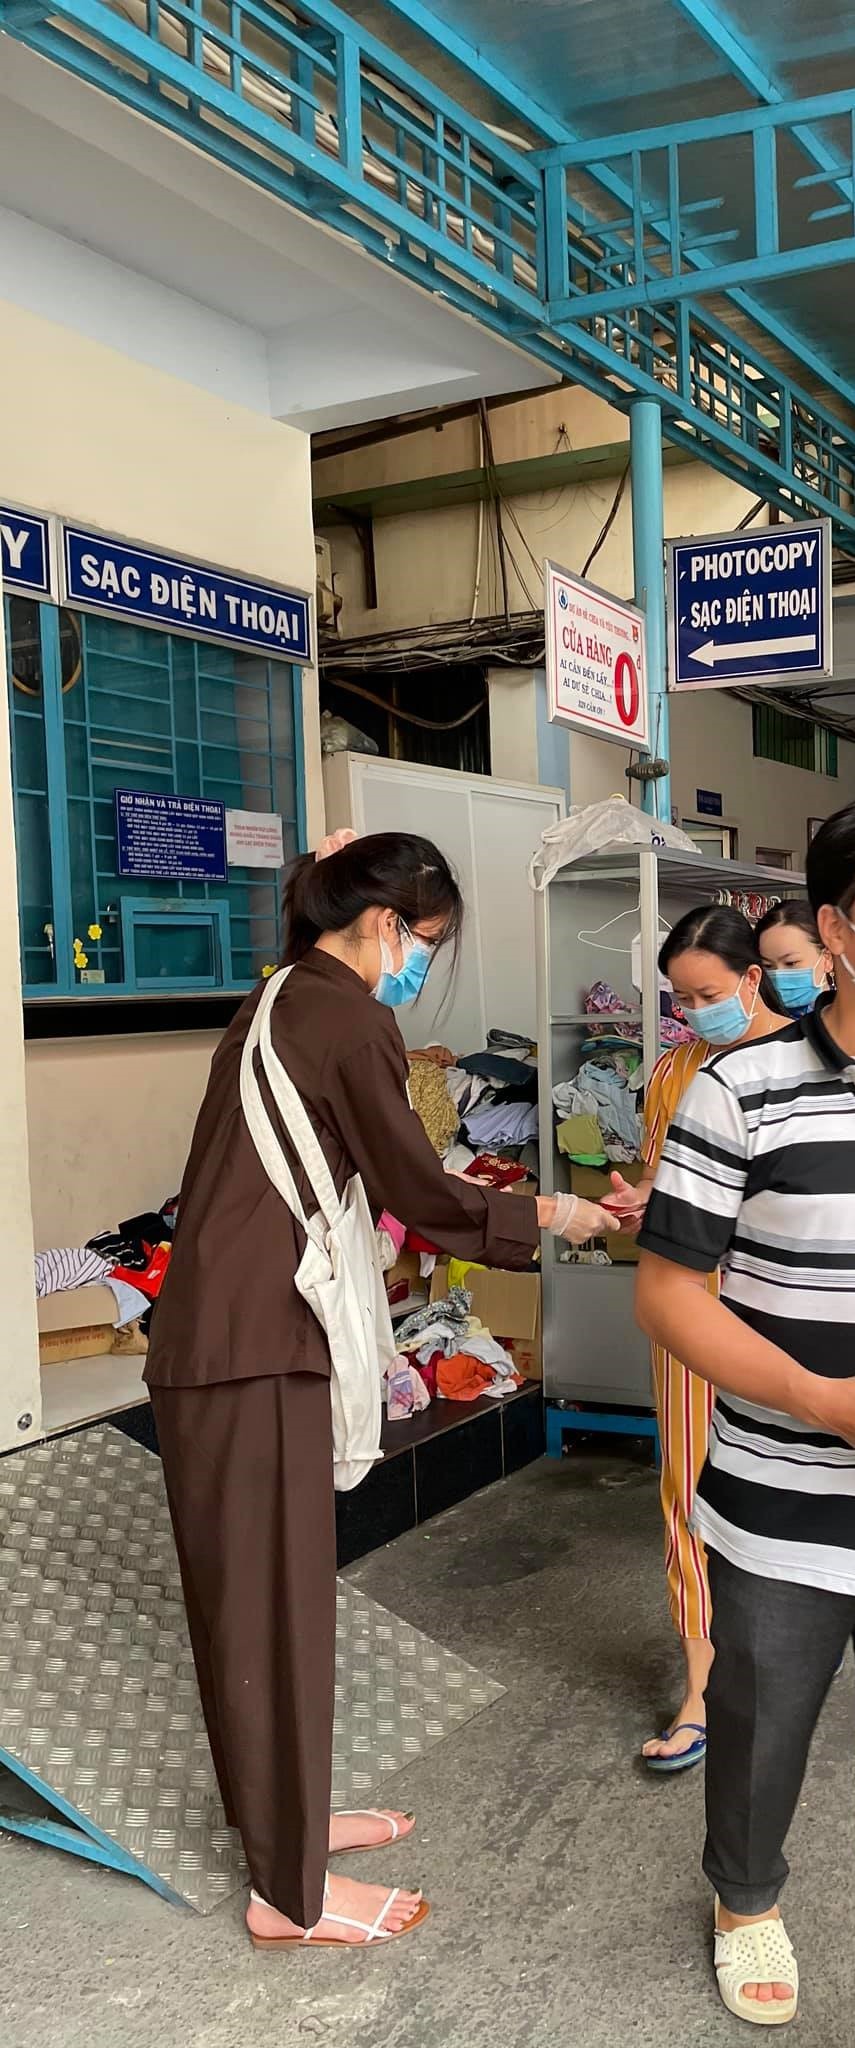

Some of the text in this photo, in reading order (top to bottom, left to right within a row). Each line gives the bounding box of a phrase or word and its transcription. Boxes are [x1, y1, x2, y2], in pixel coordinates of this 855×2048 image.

[691, 540, 817, 582] PHOTOCOPY
[80, 553, 299, 644] SẠC ĐIỆN THOẠI
[690, 587, 817, 632] SẠC ĐIỆN THOẠI
[562, 620, 613, 668] CỬA HÀNG
[560, 658, 567, 670] AI
[568, 658, 581, 675] CẦN
[582, 666, 595, 681] ĐẾN
[563, 677, 570, 688] AI
[614, 651, 639, 727] 0
[120, 794, 133, 804] GIỜ
[135, 796, 155, 807] NHẬN
[156, 798, 166, 809] VÀ
[168, 799, 182, 810] TRẢ
[183, 801, 200, 812] ĐIỆN
[201, 804, 221, 815] THOẠI
